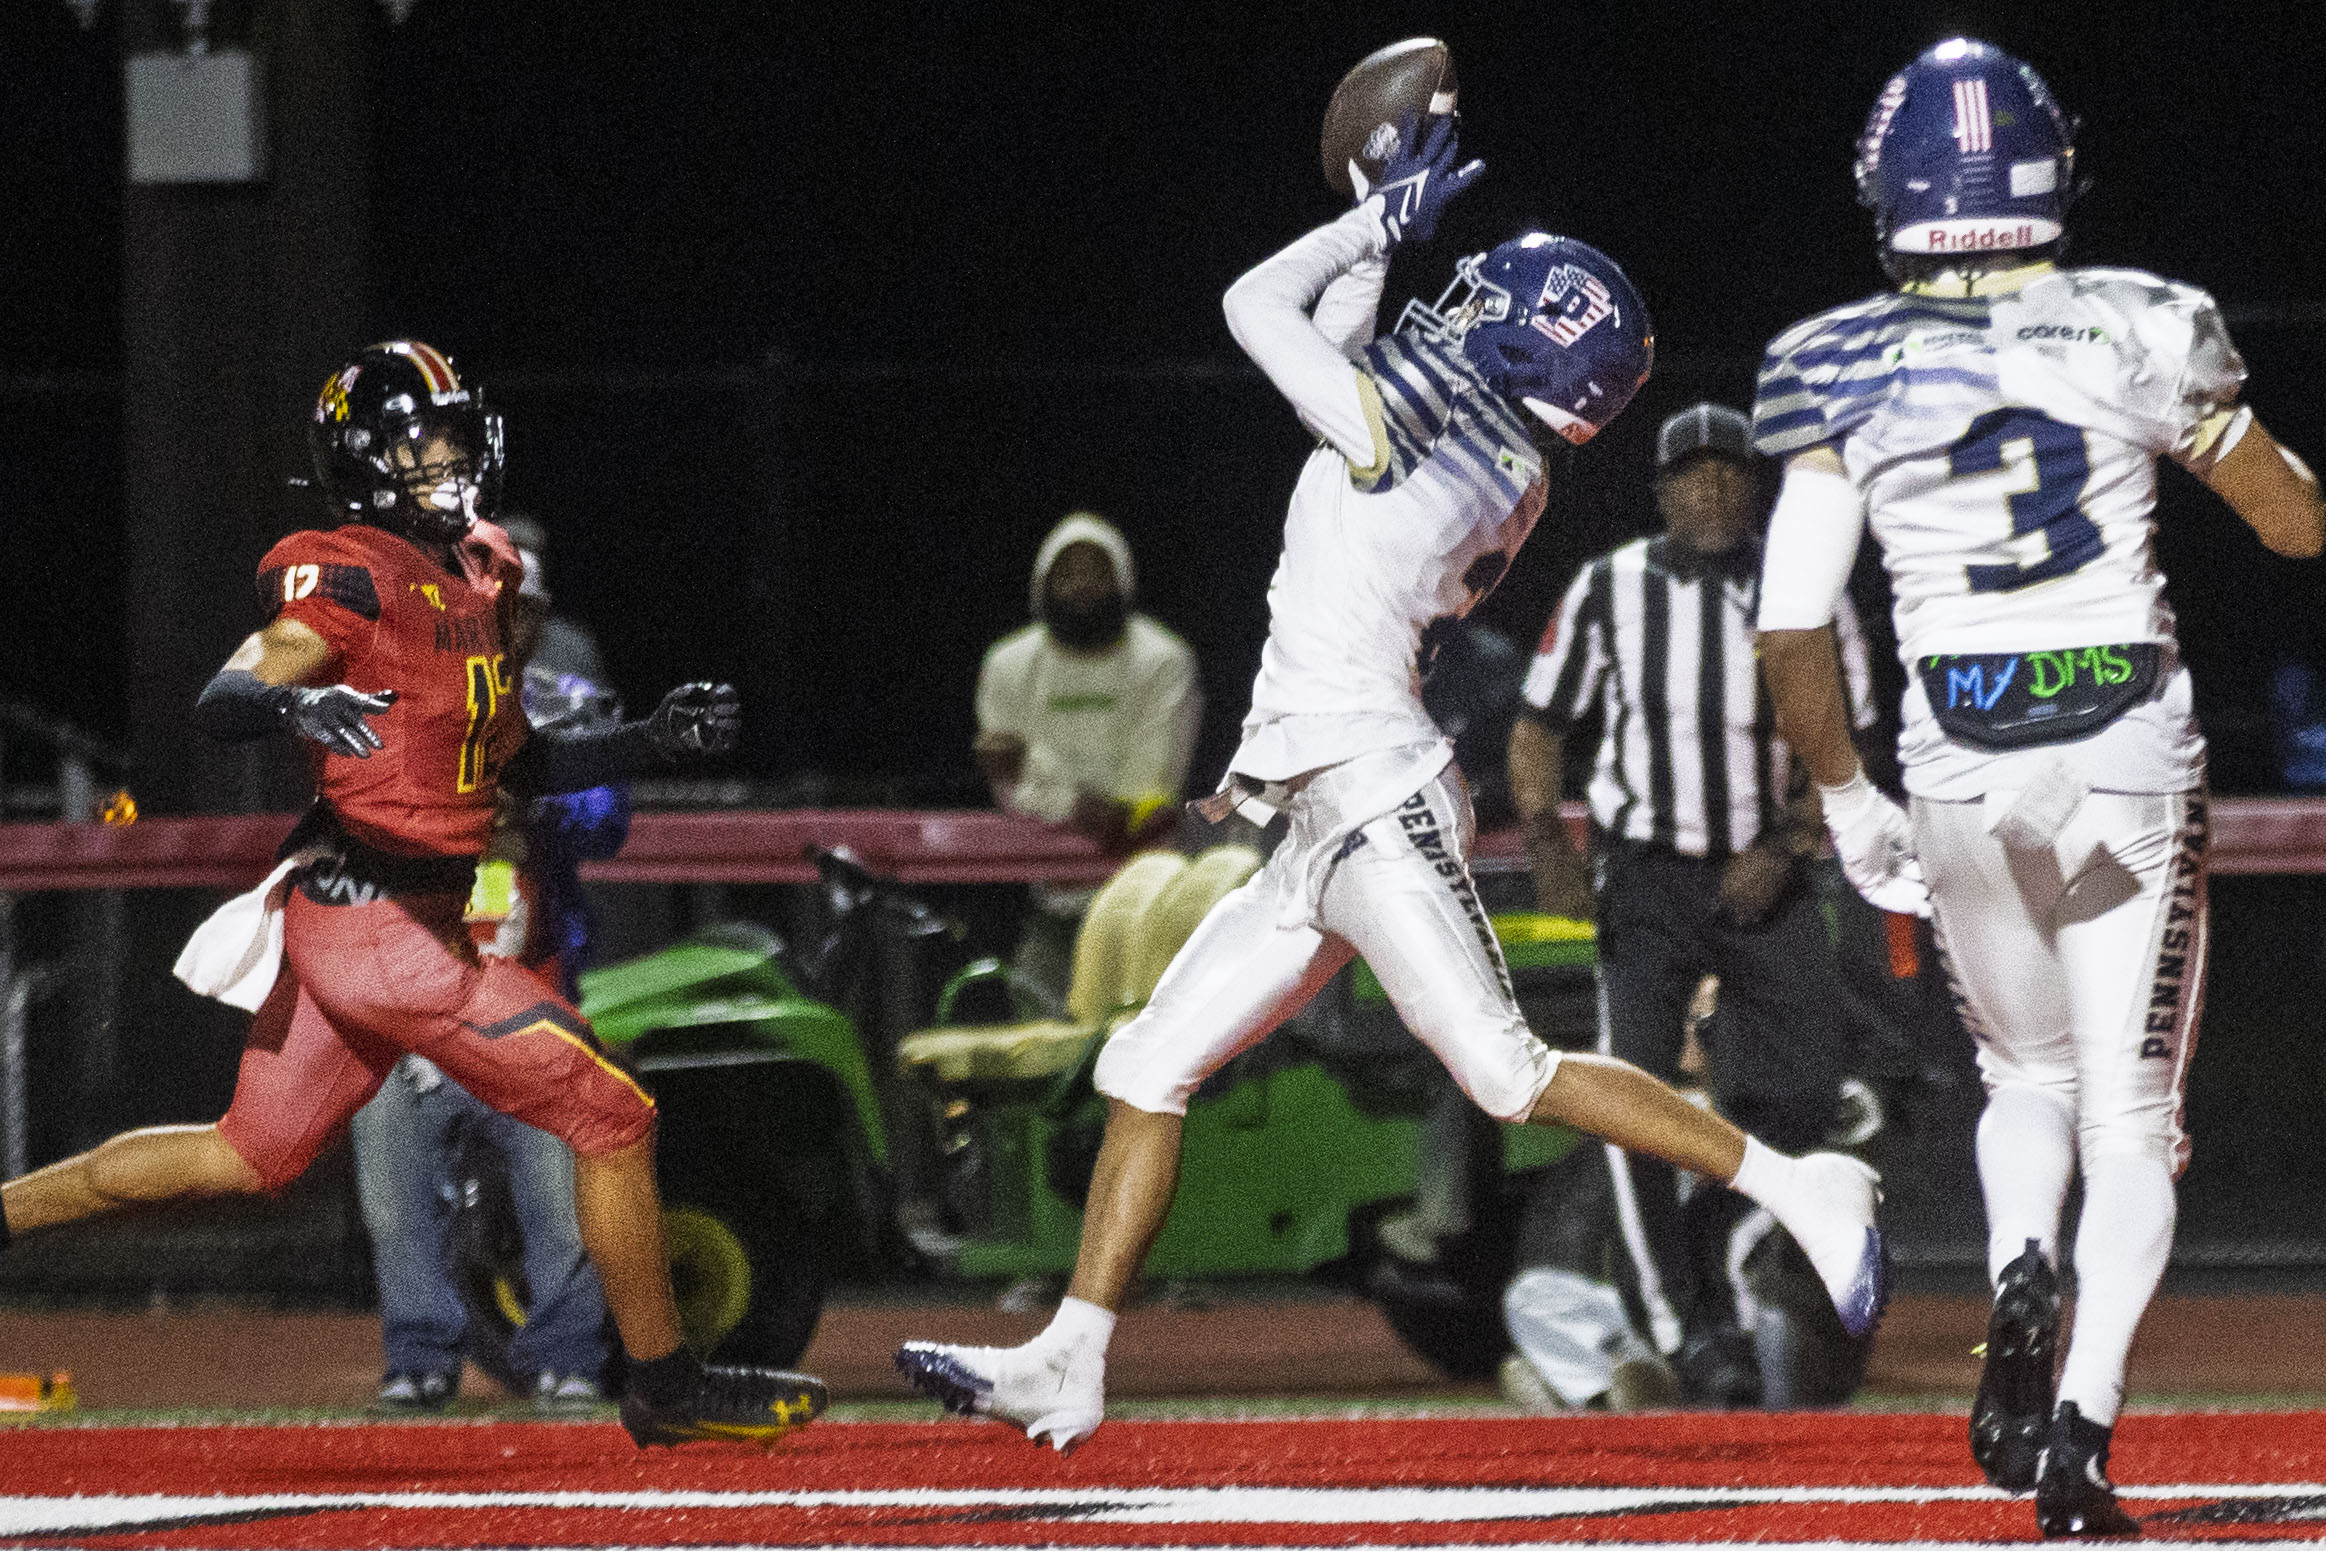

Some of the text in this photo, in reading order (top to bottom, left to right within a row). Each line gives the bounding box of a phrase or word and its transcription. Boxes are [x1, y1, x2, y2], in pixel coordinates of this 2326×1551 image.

[1929, 225, 2033, 250] Riddell
[1948, 406, 2108, 595] 3
[284, 564, 319, 602] 17
[1948, 644, 2132, 711] MY DMS
